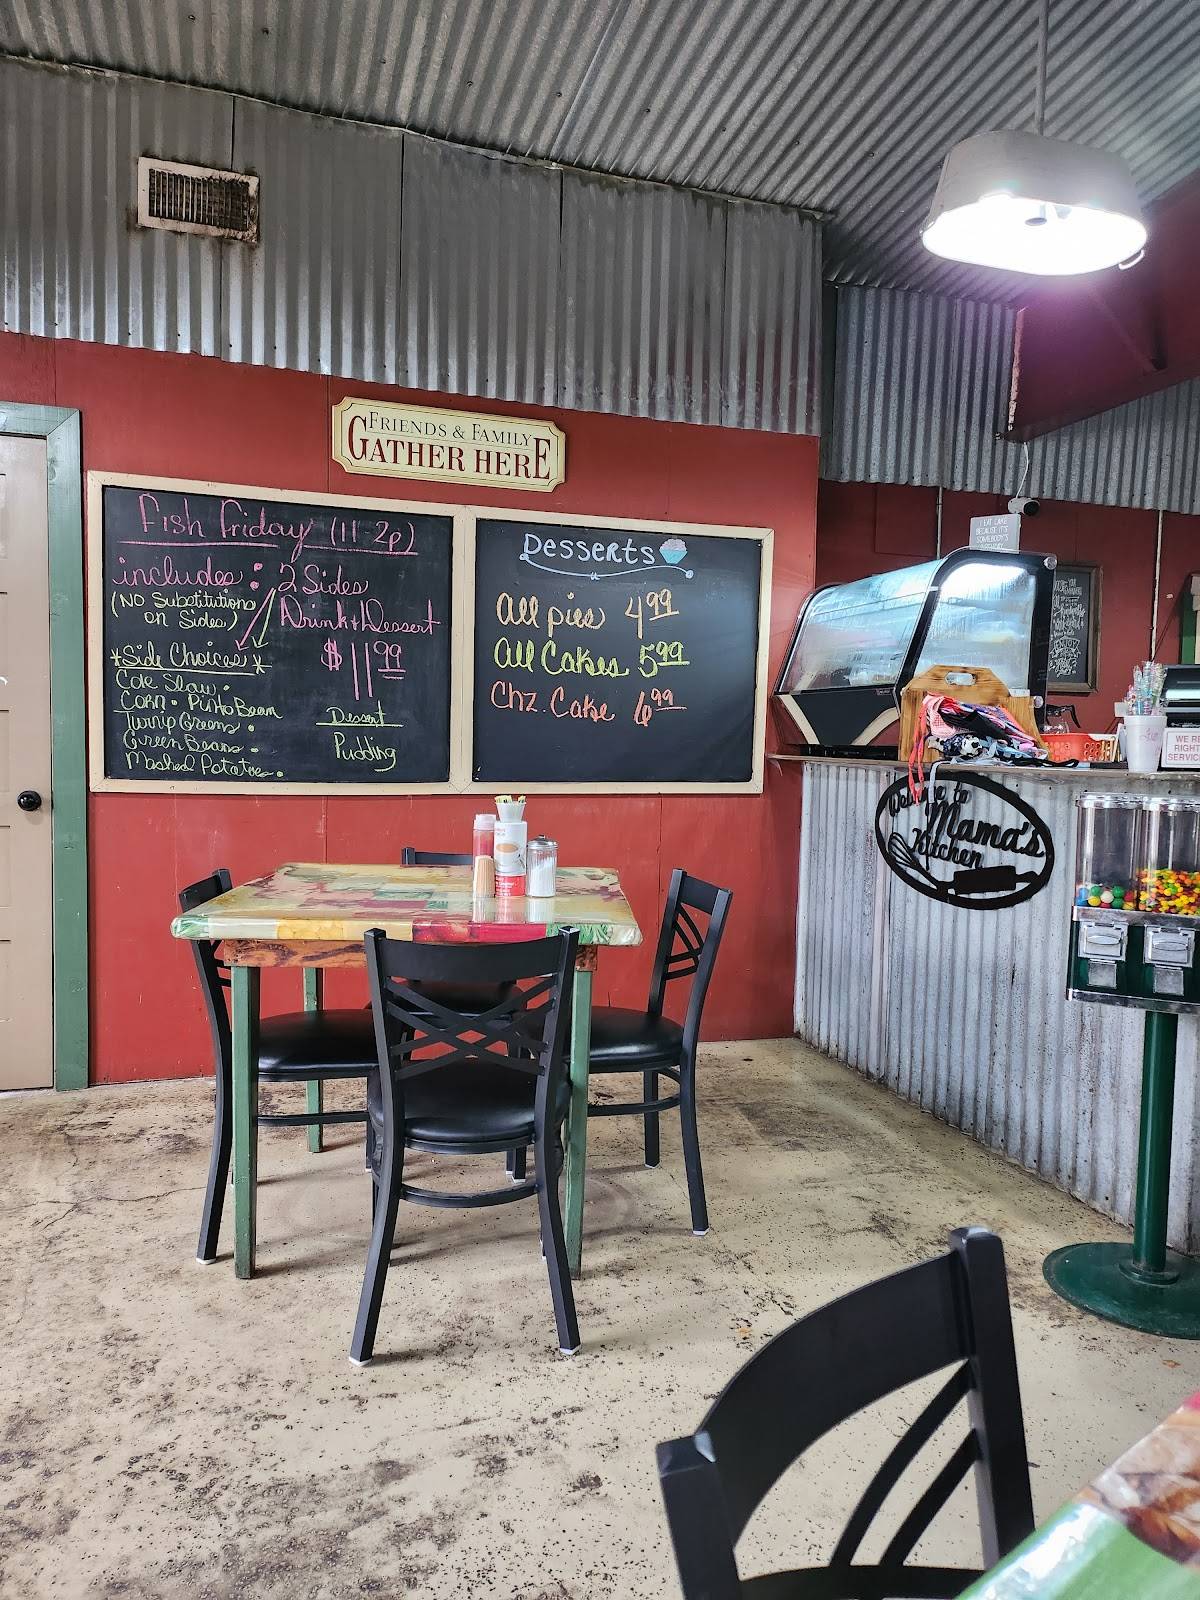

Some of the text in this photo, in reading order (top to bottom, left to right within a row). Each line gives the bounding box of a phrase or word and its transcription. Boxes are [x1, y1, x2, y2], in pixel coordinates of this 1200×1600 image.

[369, 411, 532, 447] FRIENDS & FAMILY
[348, 415, 551, 480] GATHER HERE
[138, 493, 206, 538] Fish
[220, 498, 317, 564] Friday
[523, 533, 656, 565] Desserts
[277, 562, 369, 596] 2 Sides
[144, 611, 168, 627] on
[279, 594, 349, 630] Drink
[359, 598, 441, 636] Dessert
[496, 592, 540, 629] All
[547, 591, 606, 638] pies
[169, 641, 248, 668] Choices
[493, 636, 535, 673] All
[540, 639, 630, 679] Cakes
[120, 689, 166, 711] Corn
[163, 673, 217, 696] Slaw
[325, 700, 387, 728] Dessert
[550, 686, 616, 723] Cake
[113, 709, 241, 735] Turnip Greens
[1175, 735, 1189, 743] WE
[122, 729, 245, 753] Green Beans
[333, 731, 397, 773] Pudding
[1167, 753, 1200, 762] SERVIC
[925, 800, 1045, 858] Mama's
[908, 828, 983, 869] Kitchen
